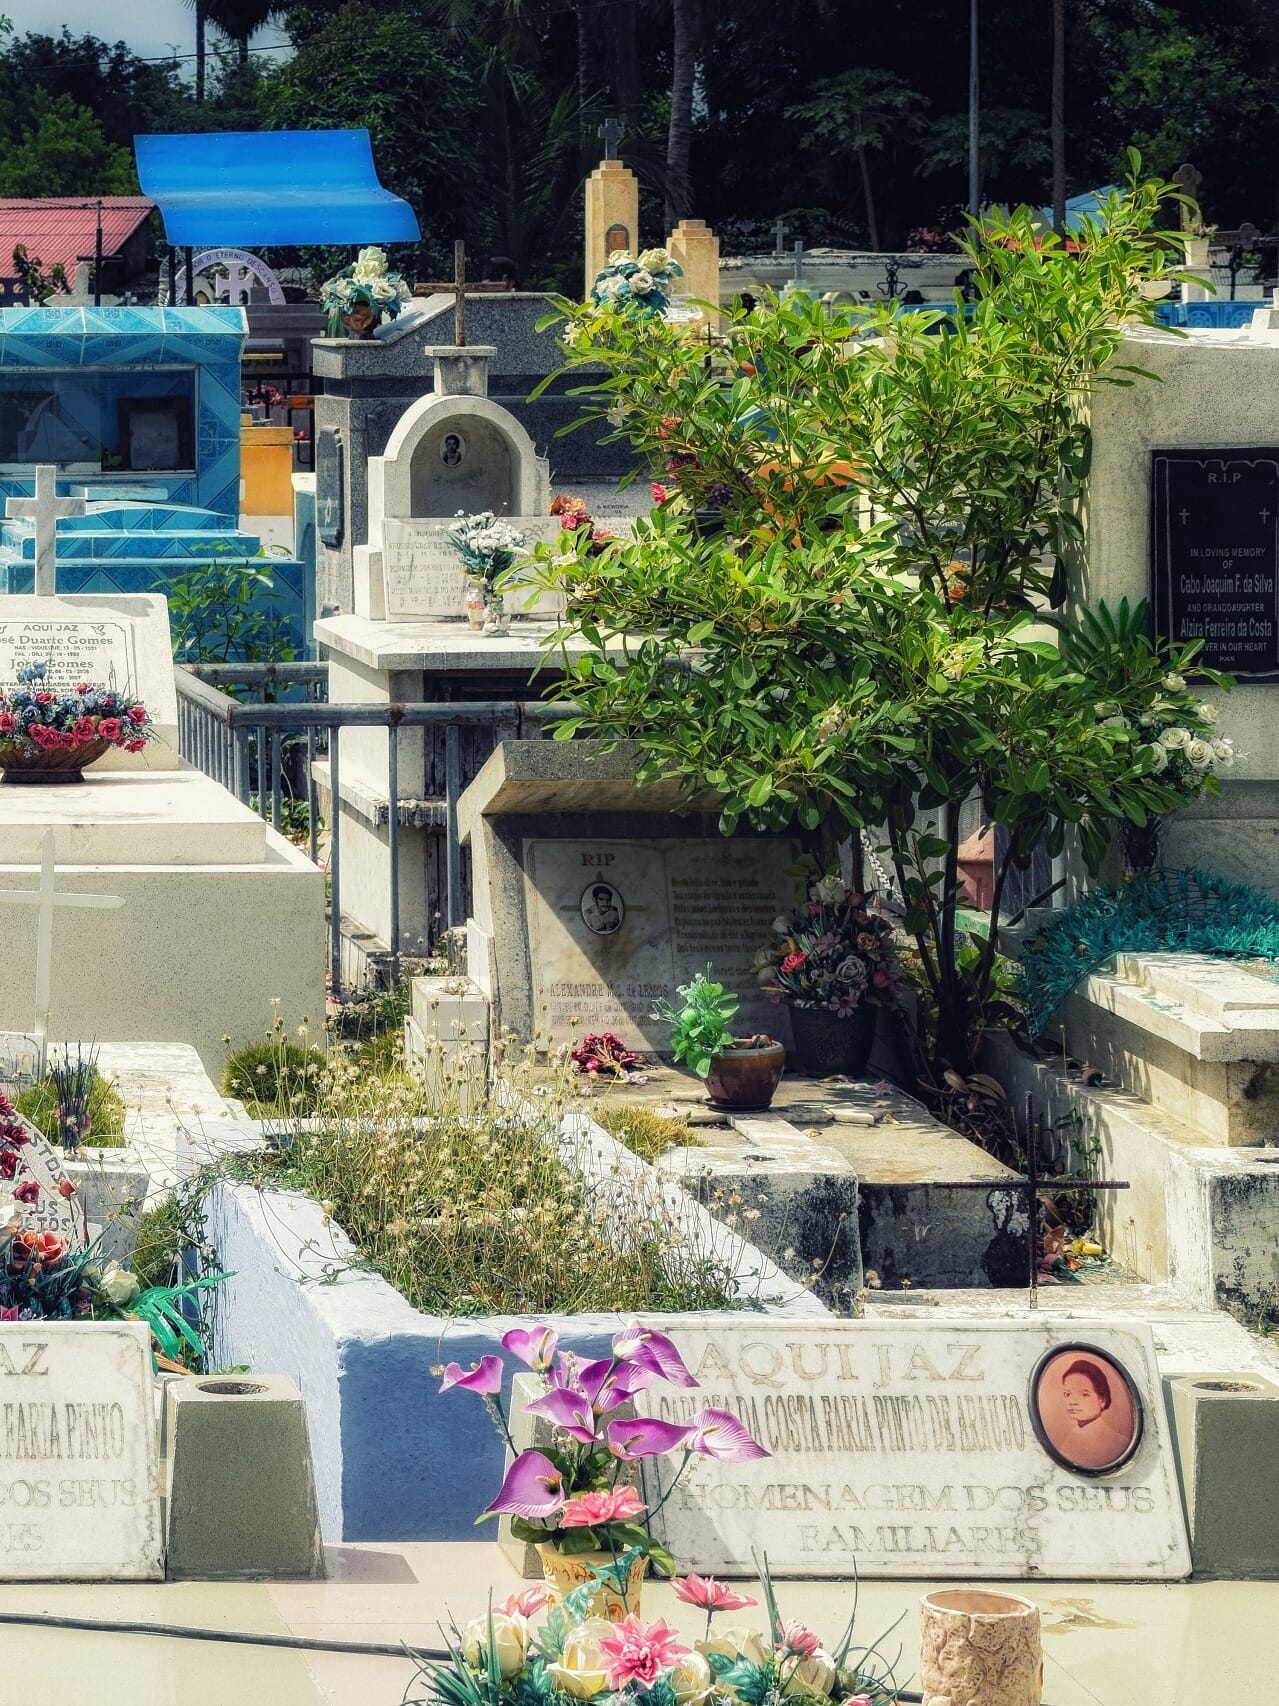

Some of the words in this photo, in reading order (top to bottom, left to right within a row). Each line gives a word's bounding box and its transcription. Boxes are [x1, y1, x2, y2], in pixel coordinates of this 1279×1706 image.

[215, 252, 245, 261] ETERNO
[1190, 548, 1199, 557] IN
[1200, 548, 1230, 557] LOVING
[1231, 548, 1267, 557] MEMORY
[1222, 560, 1234, 569] OF
[1180, 573, 1201, 594] Cabo
[1201, 573, 1234, 598] Joaquim
[1243, 573, 1254, 594] da
[1254, 573, 1273, 594] Silva
[1186, 603, 1202, 613] AND
[1202, 603, 1265, 613] GRANDDAUGHTER
[1180, 617, 1204, 638] Alzira
[1205, 617, 1237, 637] Ferreira
[1237, 617, 1248, 637] da
[1249, 617, 1272, 638] Costa
[20, 635, 64, 645] Duarte
[67, 635, 113, 645] Gomes
[1219, 642, 1227, 651] IN
[1228, 642, 1243, 651] OUR
[1244, 642, 1268, 652] HEART
[45, 659, 95, 669] Gomes
[580, 852, 617, 867] RIP
[550, 983, 604, 998] ALEXANDRE
[692, 1342, 860, 1388] AQUI
[870, 1342, 986, 1390] JAZ
[764, 1394, 821, 1452] COSTA
[822, 1394, 872, 1452] FARIA
[873, 1394, 924, 1452] PINTO
[925, 1394, 956, 1452] DE
[3, 1402, 64, 1461] FARIA
[65, 1402, 125, 1461] PINTO
[58, 1478, 138, 1509] SEUS
[678, 1483, 955, 1512] HOMENAGEM
[961, 1483, 1049, 1512] DOS
[1055, 1485, 1155, 1513] SEUS
[798, 1524, 1043, 1555] FAMILIARES
